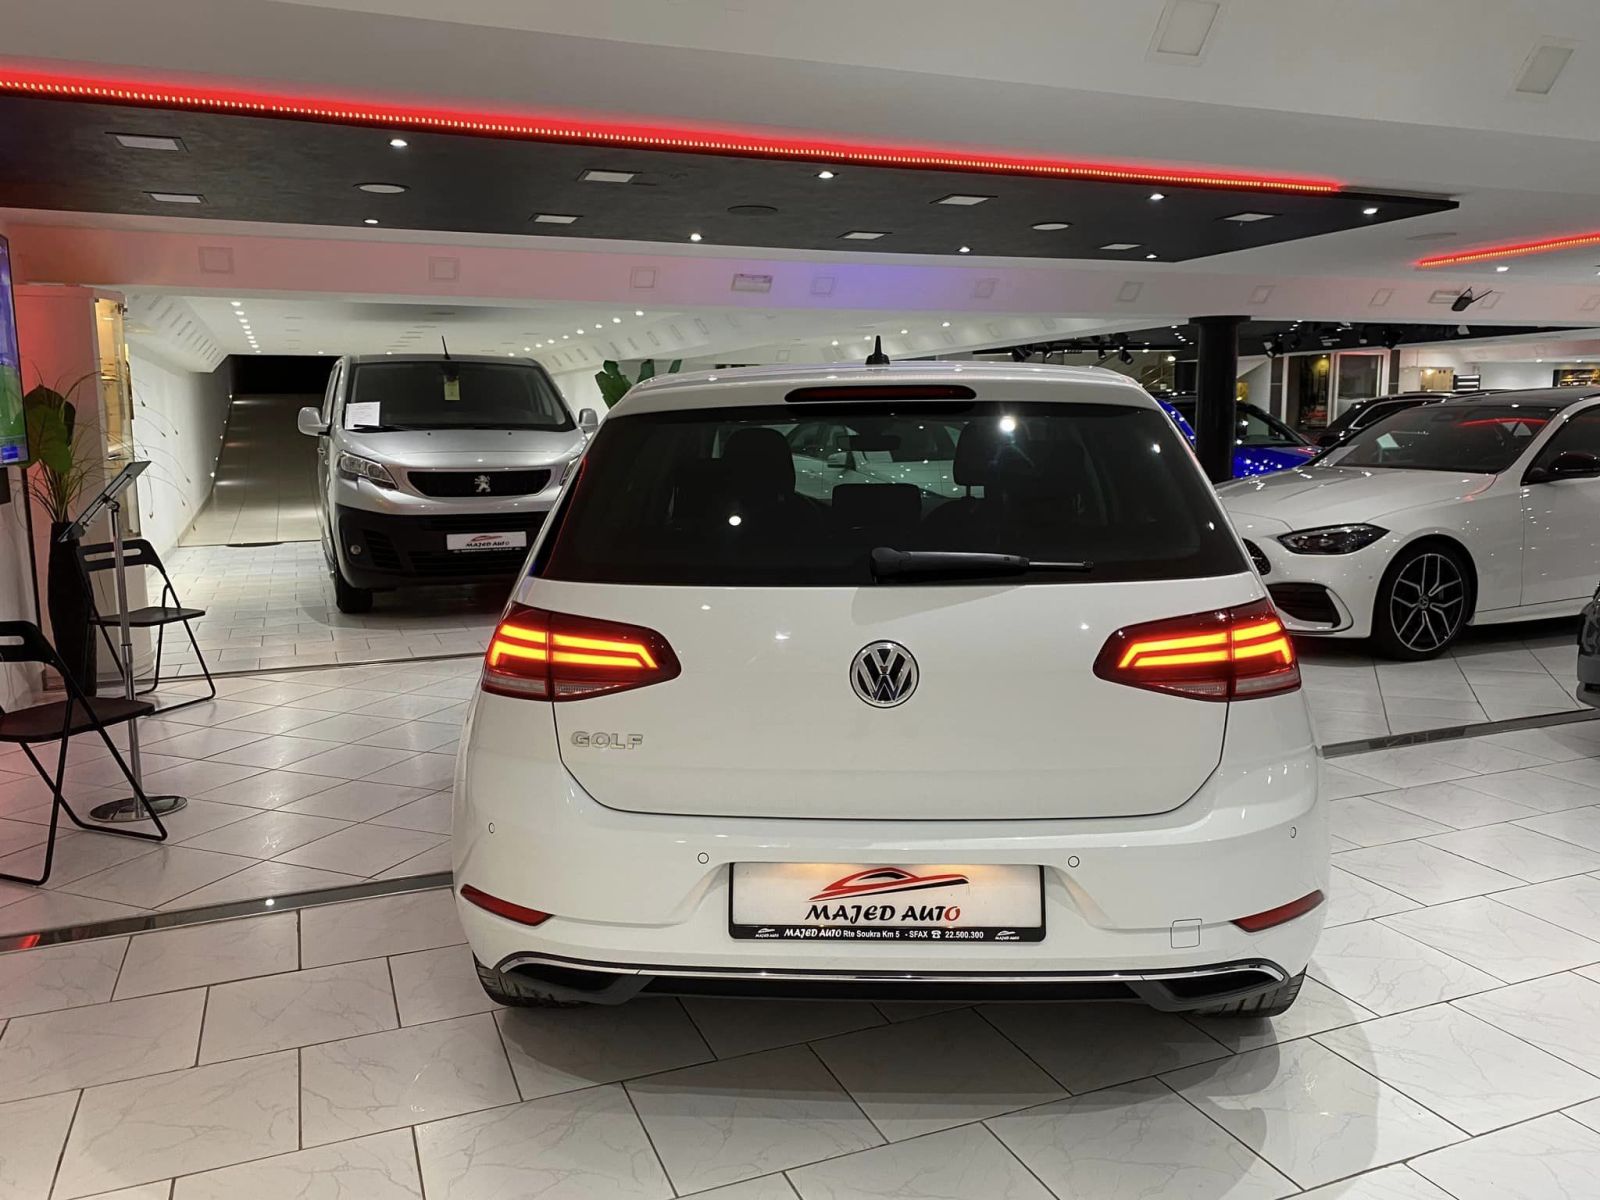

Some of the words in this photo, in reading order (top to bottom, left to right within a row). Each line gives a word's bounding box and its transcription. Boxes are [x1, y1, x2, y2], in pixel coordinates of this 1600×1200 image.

[570, 730, 644, 750] GOLF
[804, 904, 896, 925] MAJED
[900, 905, 961, 922] AUTO
[783, 928, 818, 939] MAJED
[819, 928, 842, 938] AUTO
[843, 930, 855, 938] Rte
[856, 930, 881, 938] Soukra
[882, 930, 894, 938] Km
[895, 930, 900, 938] 5
[945, 930, 985, 939] 22.500.300
